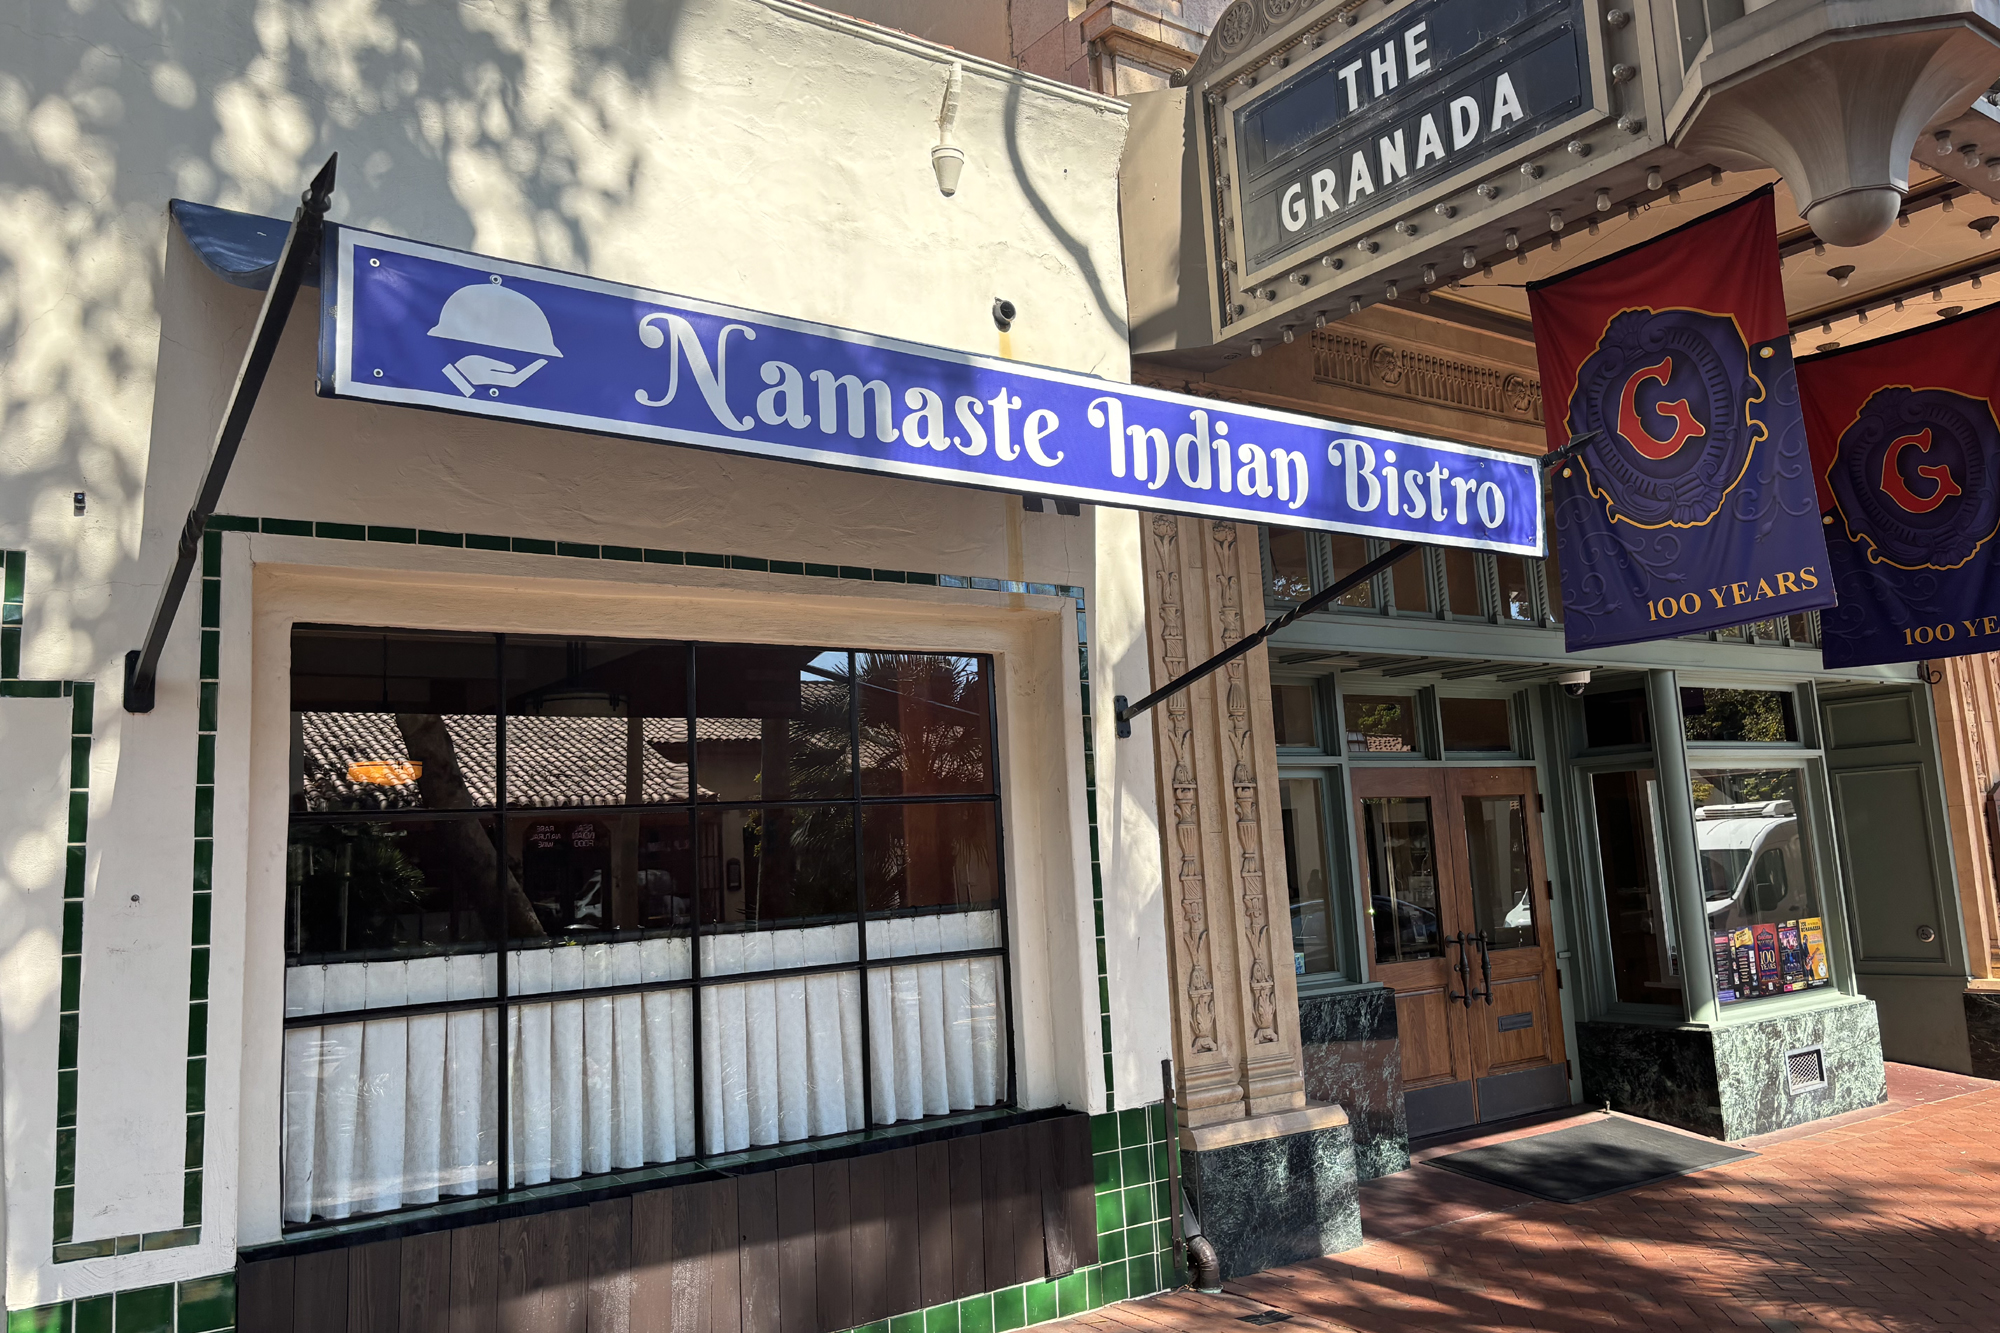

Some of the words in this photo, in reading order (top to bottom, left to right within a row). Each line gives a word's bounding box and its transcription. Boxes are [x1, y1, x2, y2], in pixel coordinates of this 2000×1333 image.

[1337, 20, 1431, 112] THE
[1281, 72, 1524, 232] GRANADA
[634, 312, 1064, 468] Namaste
[1087, 396, 1309, 510] Indian
[1327, 439, 1506, 530] Bistro
[1616, 356, 1706, 460] G
[1880, 427, 1962, 514] G
[1646, 592, 1702, 622] 100
[1708, 566, 1819, 609] YEARS
[1903, 623, 1956, 646] 100
[1759, 949, 1776, 964] 100
[1760, 963, 1776, 971] YEARS
